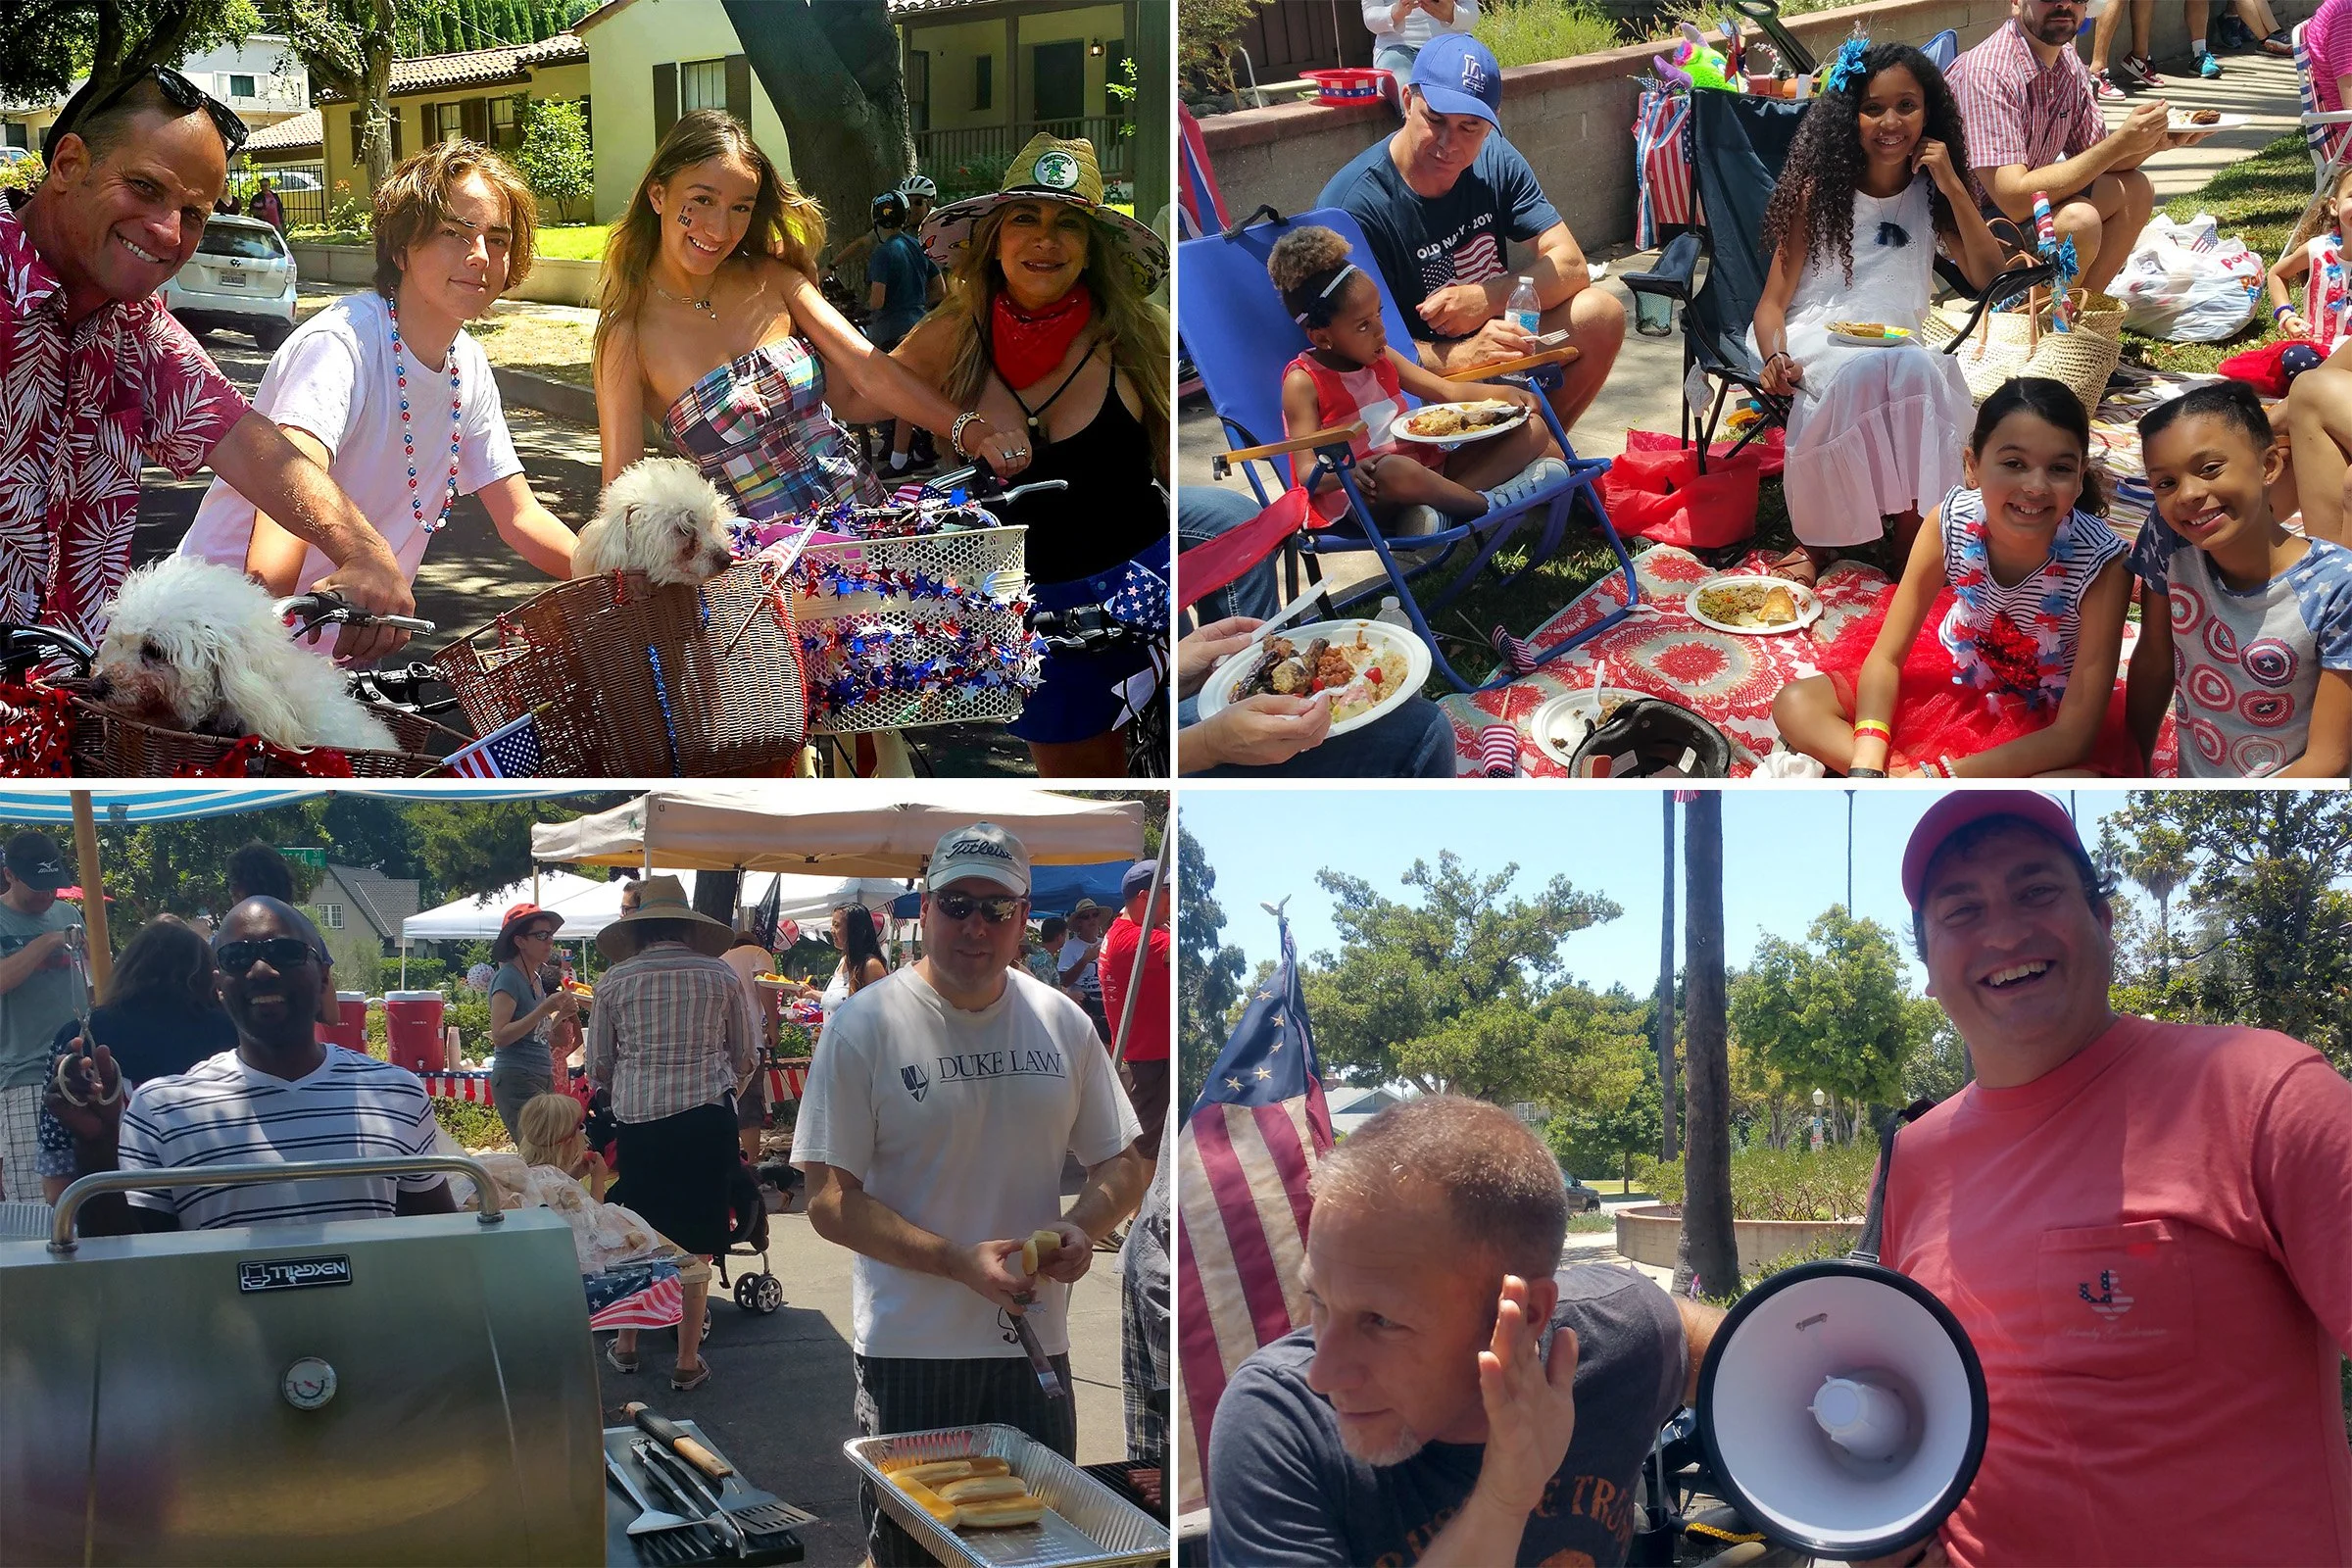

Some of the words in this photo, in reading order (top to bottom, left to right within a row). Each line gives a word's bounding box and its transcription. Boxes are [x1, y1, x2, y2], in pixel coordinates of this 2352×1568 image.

[1462, 54, 1487, 93] LA
[677, 214, 692, 227] USA
[1416, 243, 1442, 260] OLD
[945, 839, 1013, 860] Titleist
[936, 1051, 1004, 1079] DUKE
[1008, 1050, 1061, 1074] LAW
